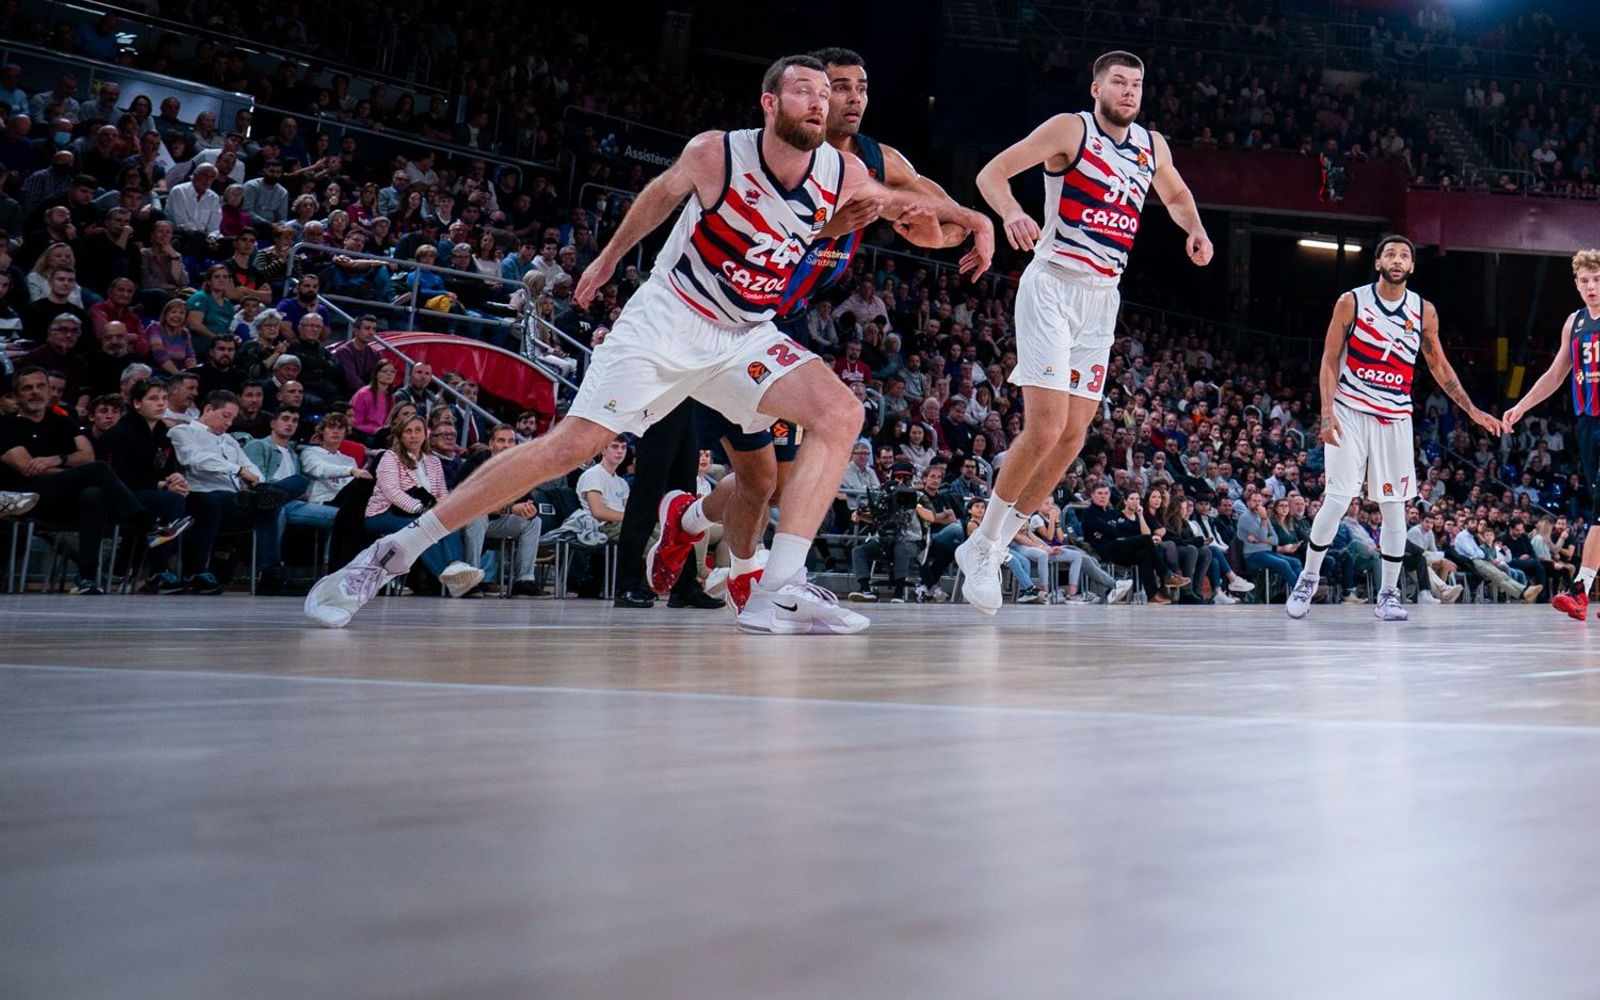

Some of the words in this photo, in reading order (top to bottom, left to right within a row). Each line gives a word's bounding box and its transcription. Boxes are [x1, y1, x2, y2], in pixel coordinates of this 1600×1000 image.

[624, 144, 676, 168] Assistènc
[1103, 175, 1130, 206] 31
[1081, 208, 1138, 233] CAZOO
[745, 231, 794, 269] 24
[1582, 340, 1600, 364] 31
[1356, 367, 1404, 385] CAZOO
[1400, 476, 1409, 497] 7
